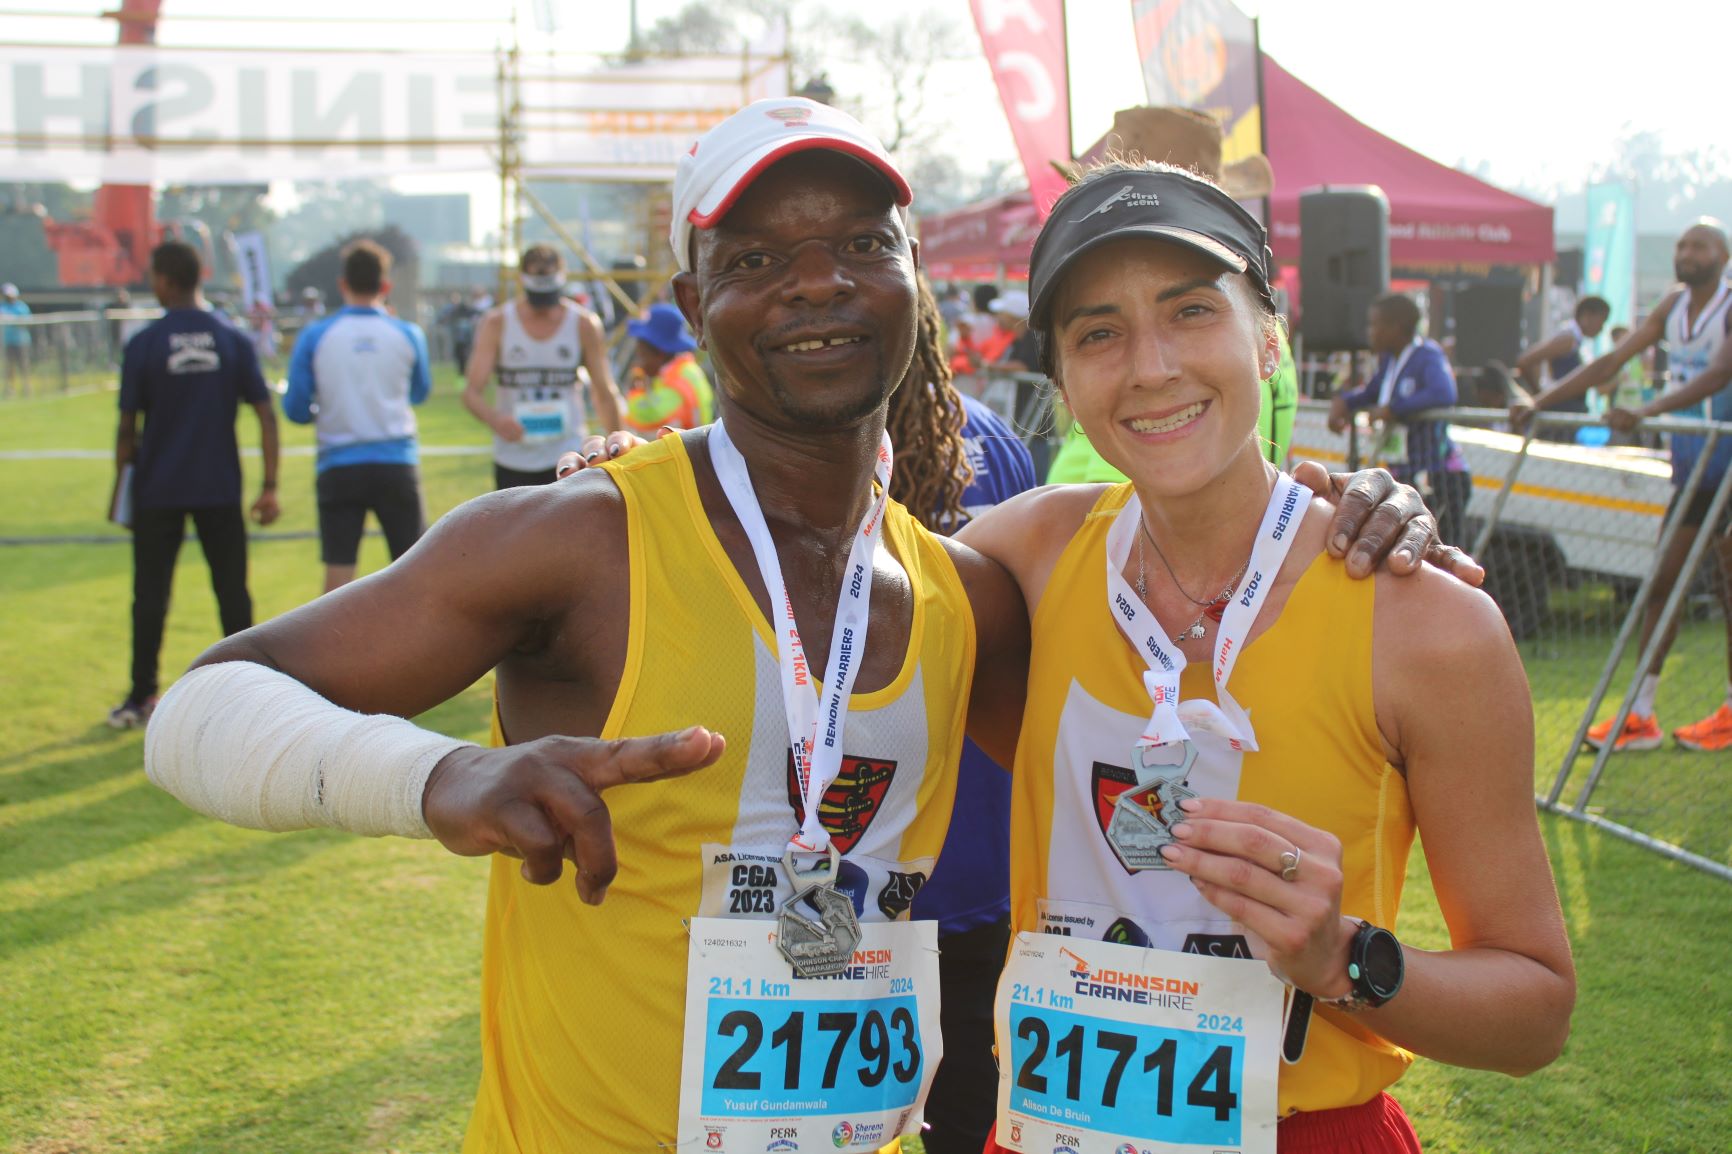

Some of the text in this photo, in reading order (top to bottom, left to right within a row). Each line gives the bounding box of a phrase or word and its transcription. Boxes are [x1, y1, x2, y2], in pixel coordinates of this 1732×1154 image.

[1272, 484, 1302, 541] HARRIERS
[1240, 571, 1262, 607] 2024
[1115, 593, 1135, 621] 2024
[824, 564, 864, 748] BENONI HARRIERS 2024
[713, 853, 736, 864] ASA
[738, 853, 766, 862] License
[732, 865, 777, 888] CGA
[730, 889, 775, 913] 2023
[1064, 914, 1086, 925] issued
[1087, 917, 1095, 928] by
[709, 976, 790, 997] 21.1 km
[890, 977, 914, 994] 2024
[1090, 969, 1199, 996] JOHNSON
[1012, 983, 1074, 1009] 21.1 km
[1196, 1013, 1243, 1033] 2024
[712, 1007, 921, 1091] 21793
[1016, 1016, 1238, 1122] 21714
[724, 1099, 828, 1111] Yusuf Gundamwala
[1022, 1097, 1048, 1114] Alison
[1050, 1104, 1062, 1117] De
[1064, 1108, 1091, 1122] Bruin
[770, 1127, 798, 1139] PEAK
[1055, 1132, 1081, 1148] PEAK
